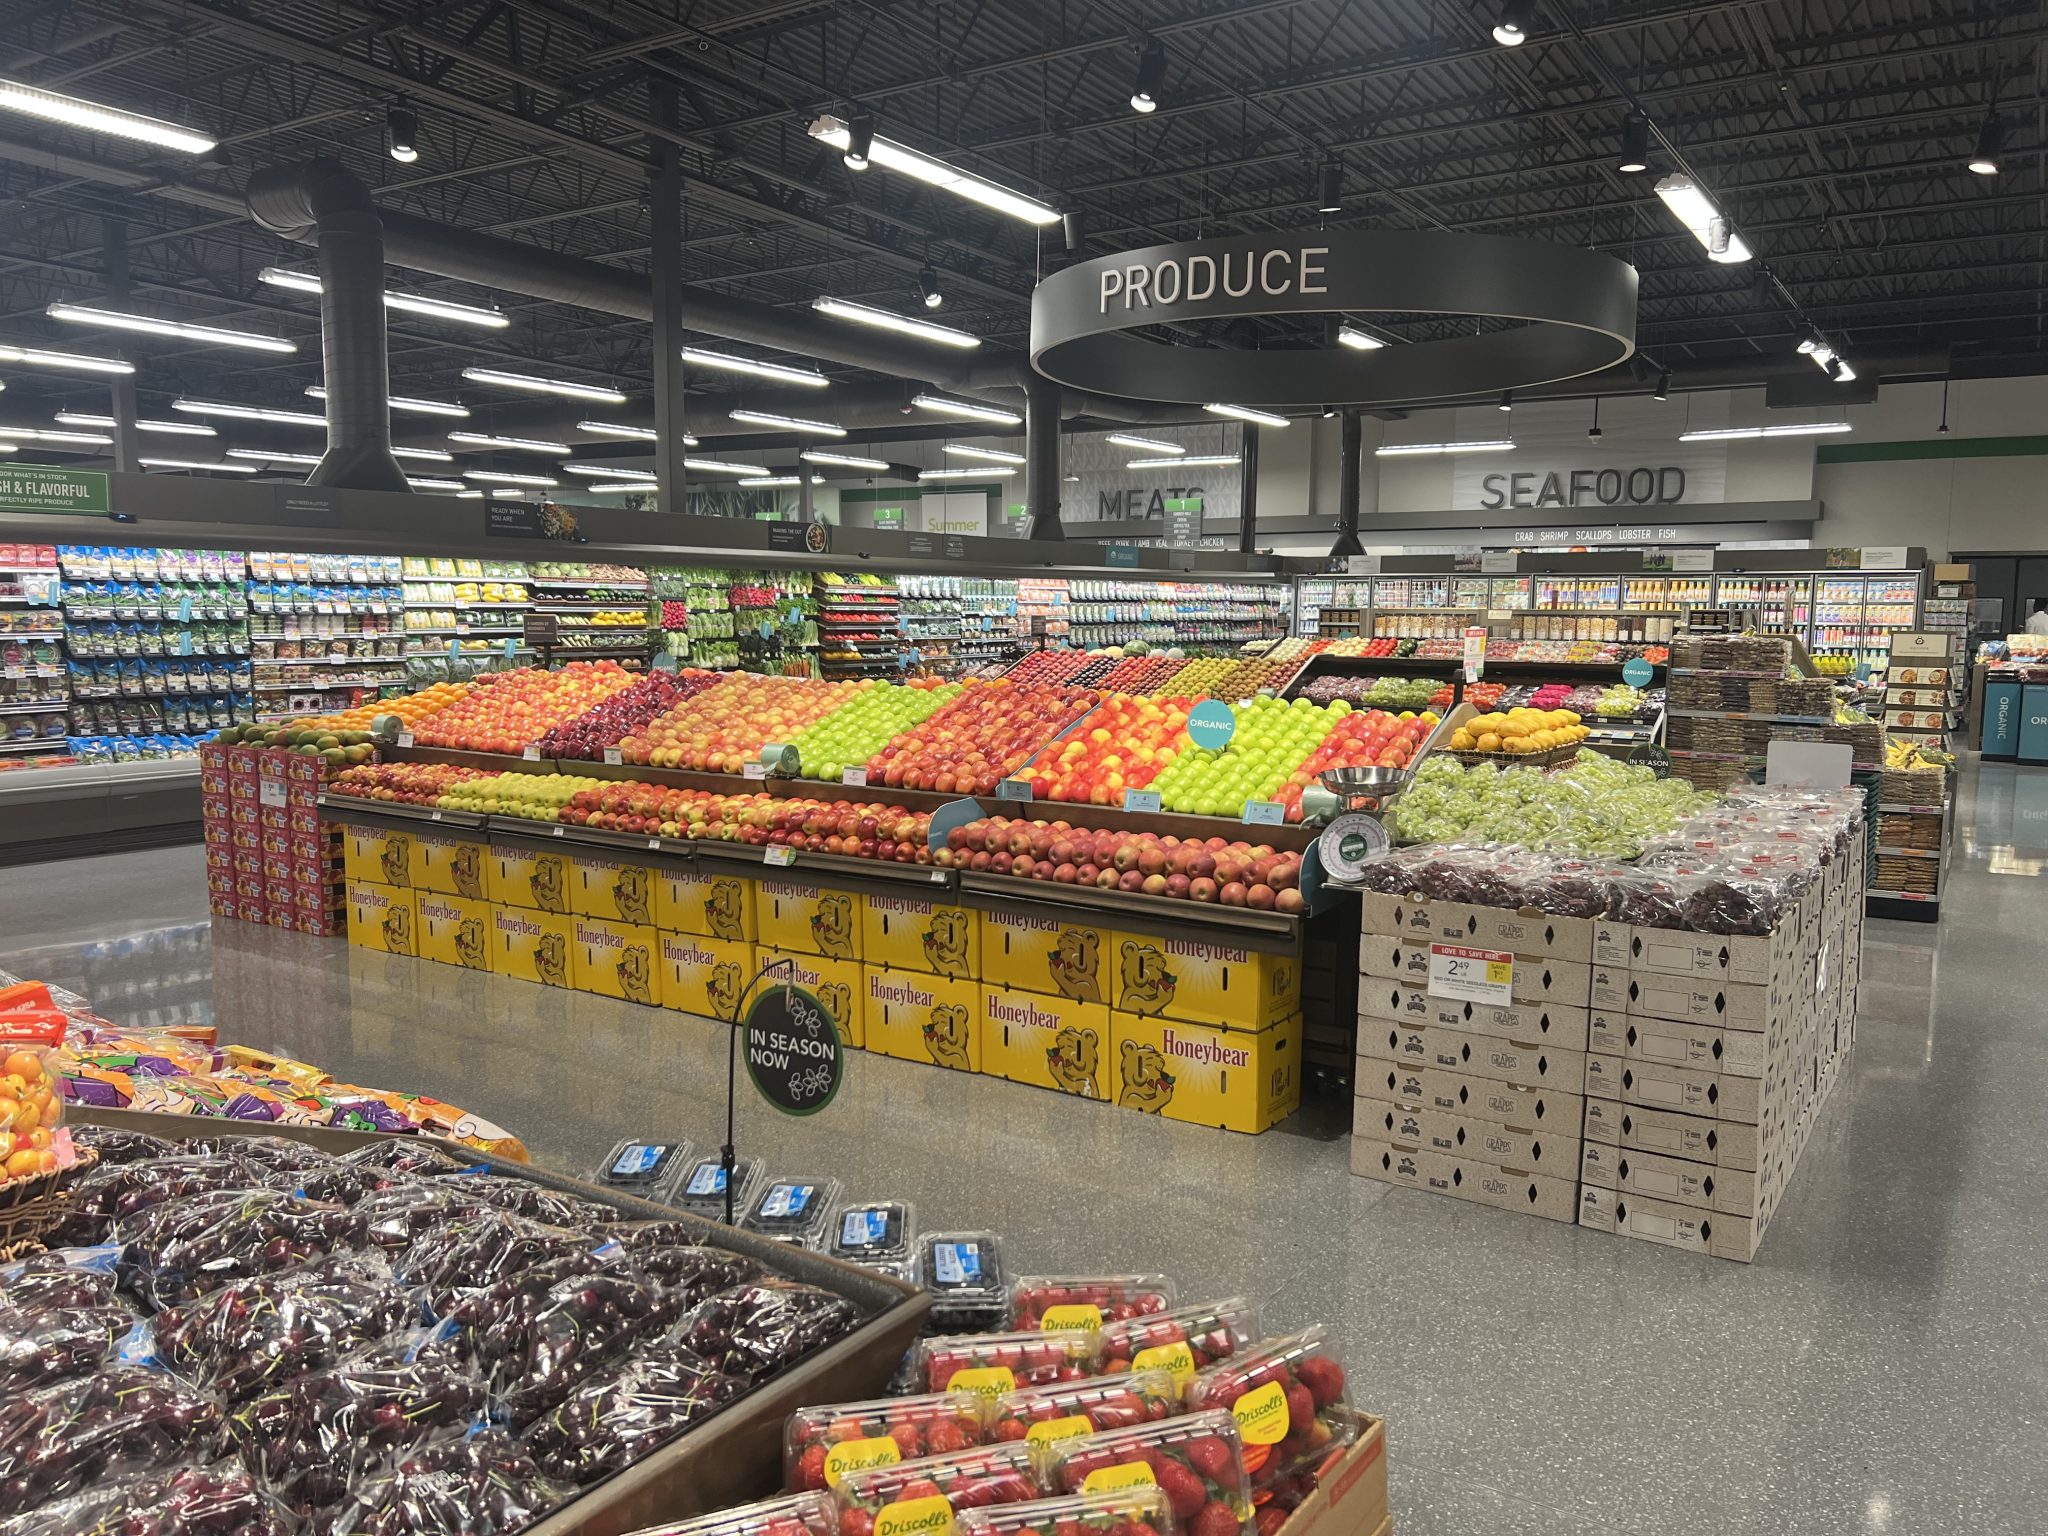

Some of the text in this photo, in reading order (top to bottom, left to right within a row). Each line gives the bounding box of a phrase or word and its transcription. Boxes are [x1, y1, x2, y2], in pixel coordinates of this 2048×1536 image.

[1100, 247, 1329, 314] PRODUCE
[14, 481, 23, 494] &
[26, 482, 91, 498] FLAVORFUL
[1480, 467, 1687, 509] SEAFOOD
[884, 509, 891, 519] 3
[1020, 505, 1026, 515] 2
[1180, 500, 1186, 510] 1
[928, 518, 980, 532] Summer
[1515, 528, 1676, 542] CRAB SHRIMP SCALLOPS LOBSTER FISH
[1200, 538, 1224, 547] CHICKEN
[1190, 718, 1232, 731] ORGANIC
[1997, 696, 2009, 740] ORGANIC
[1639, 759, 1669, 767] SEASON
[347, 823, 387, 841] Honeybear
[490, 844, 537, 862] Honeybear
[661, 868, 713, 885] Honeybear
[349, 886, 390, 909] Honeybear
[761, 879, 819, 901] Honeybear
[420, 897, 461, 922] Honeybear
[869, 895, 934, 915] Honeybear
[496, 911, 541, 937] Honeybear
[576, 922, 624, 949] Honeybear
[663, 938, 715, 966] Honeybear
[1164, 937, 1248, 963] Honeybear
[1441, 947, 1456, 955] LOVE
[1468, 951, 1483, 959] SAVE
[1491, 963, 1507, 971] SAVE
[870, 975, 934, 1007] Honeybear
[988, 995, 1060, 1030] Honeybear
[750, 1028, 835, 1061] IN SEASON
[1163, 1029, 1249, 1067] Honeybear
[750, 1047, 789, 1071] NOW
[1044, 1317, 1099, 1331] Driscoll's
[1235, 1394, 1283, 1426] Driscoll's
[830, 1453, 896, 1473] Driscoll's
[880, 1511, 949, 1536] Driscoll's
